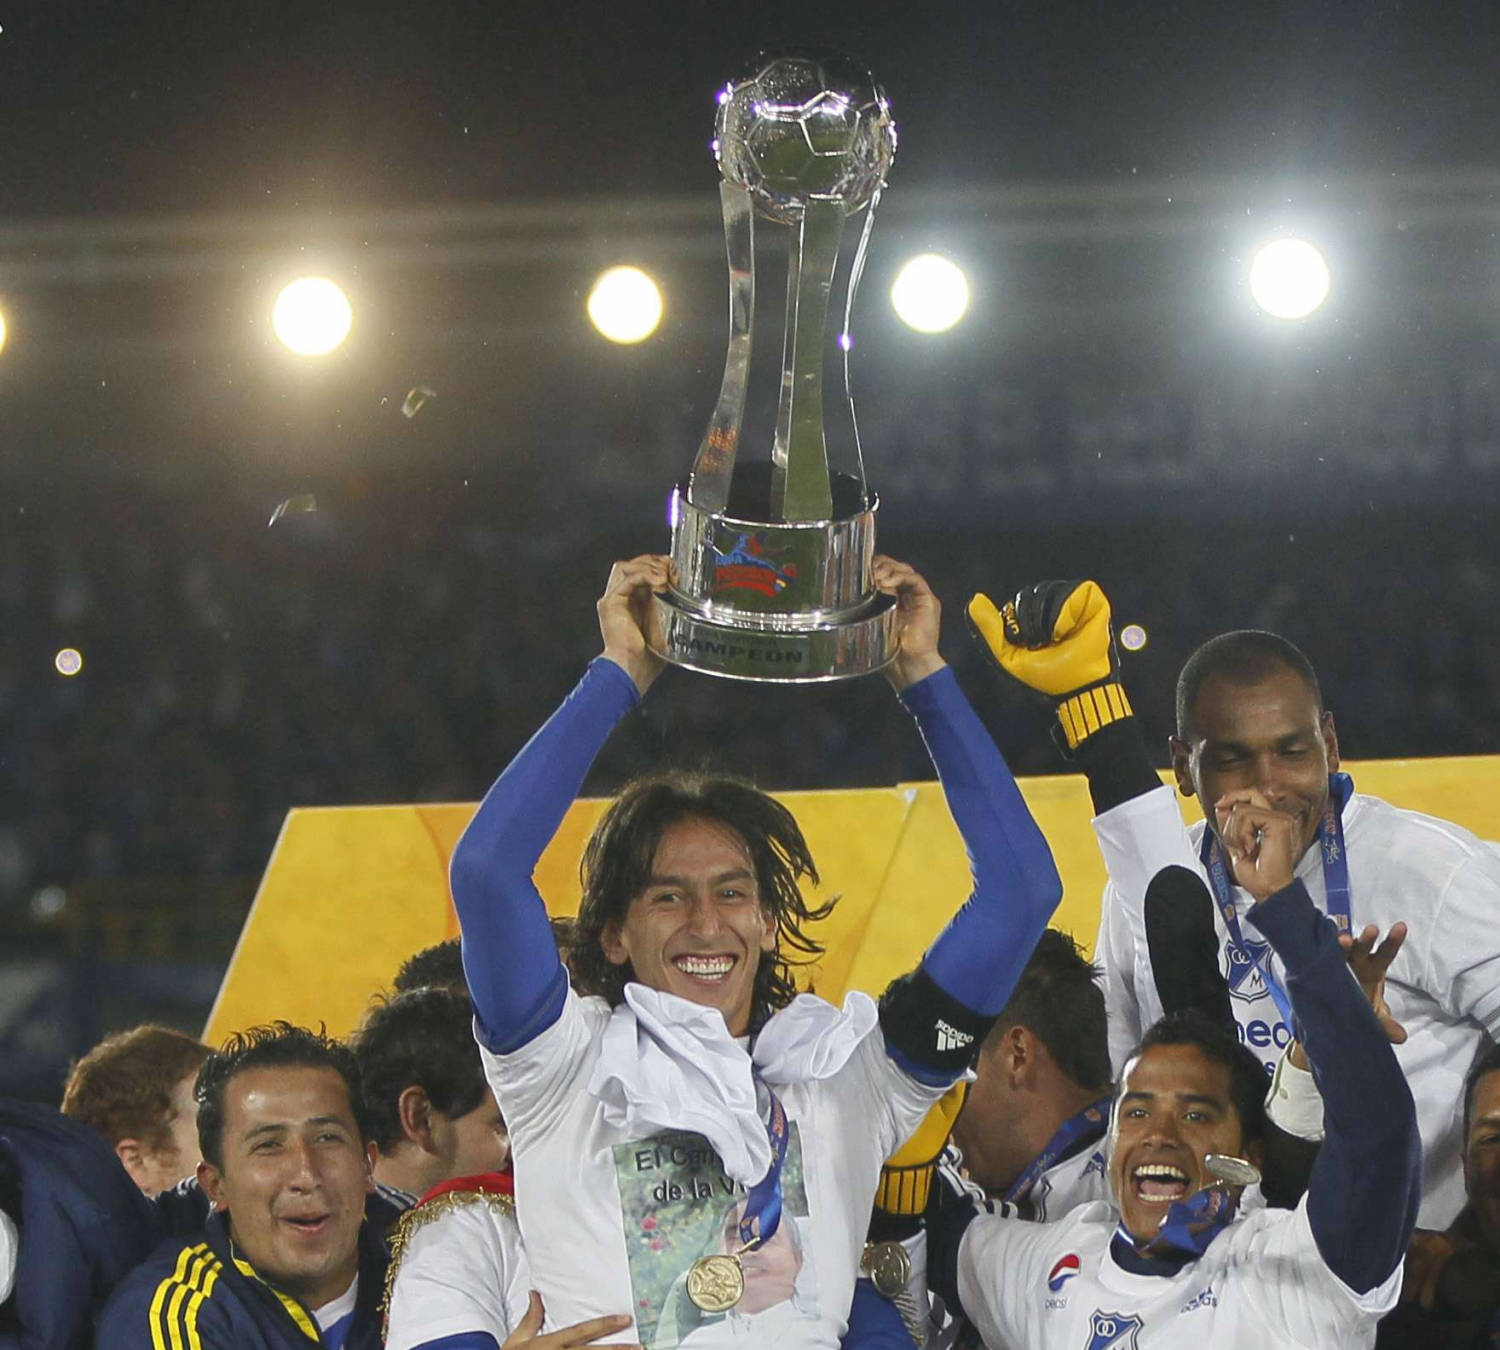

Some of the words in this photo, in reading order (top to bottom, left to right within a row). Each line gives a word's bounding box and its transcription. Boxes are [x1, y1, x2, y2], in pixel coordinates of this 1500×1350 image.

[635, 1149, 660, 1172] El
[653, 1179, 684, 1202] de
[692, 1177, 713, 1200] la
